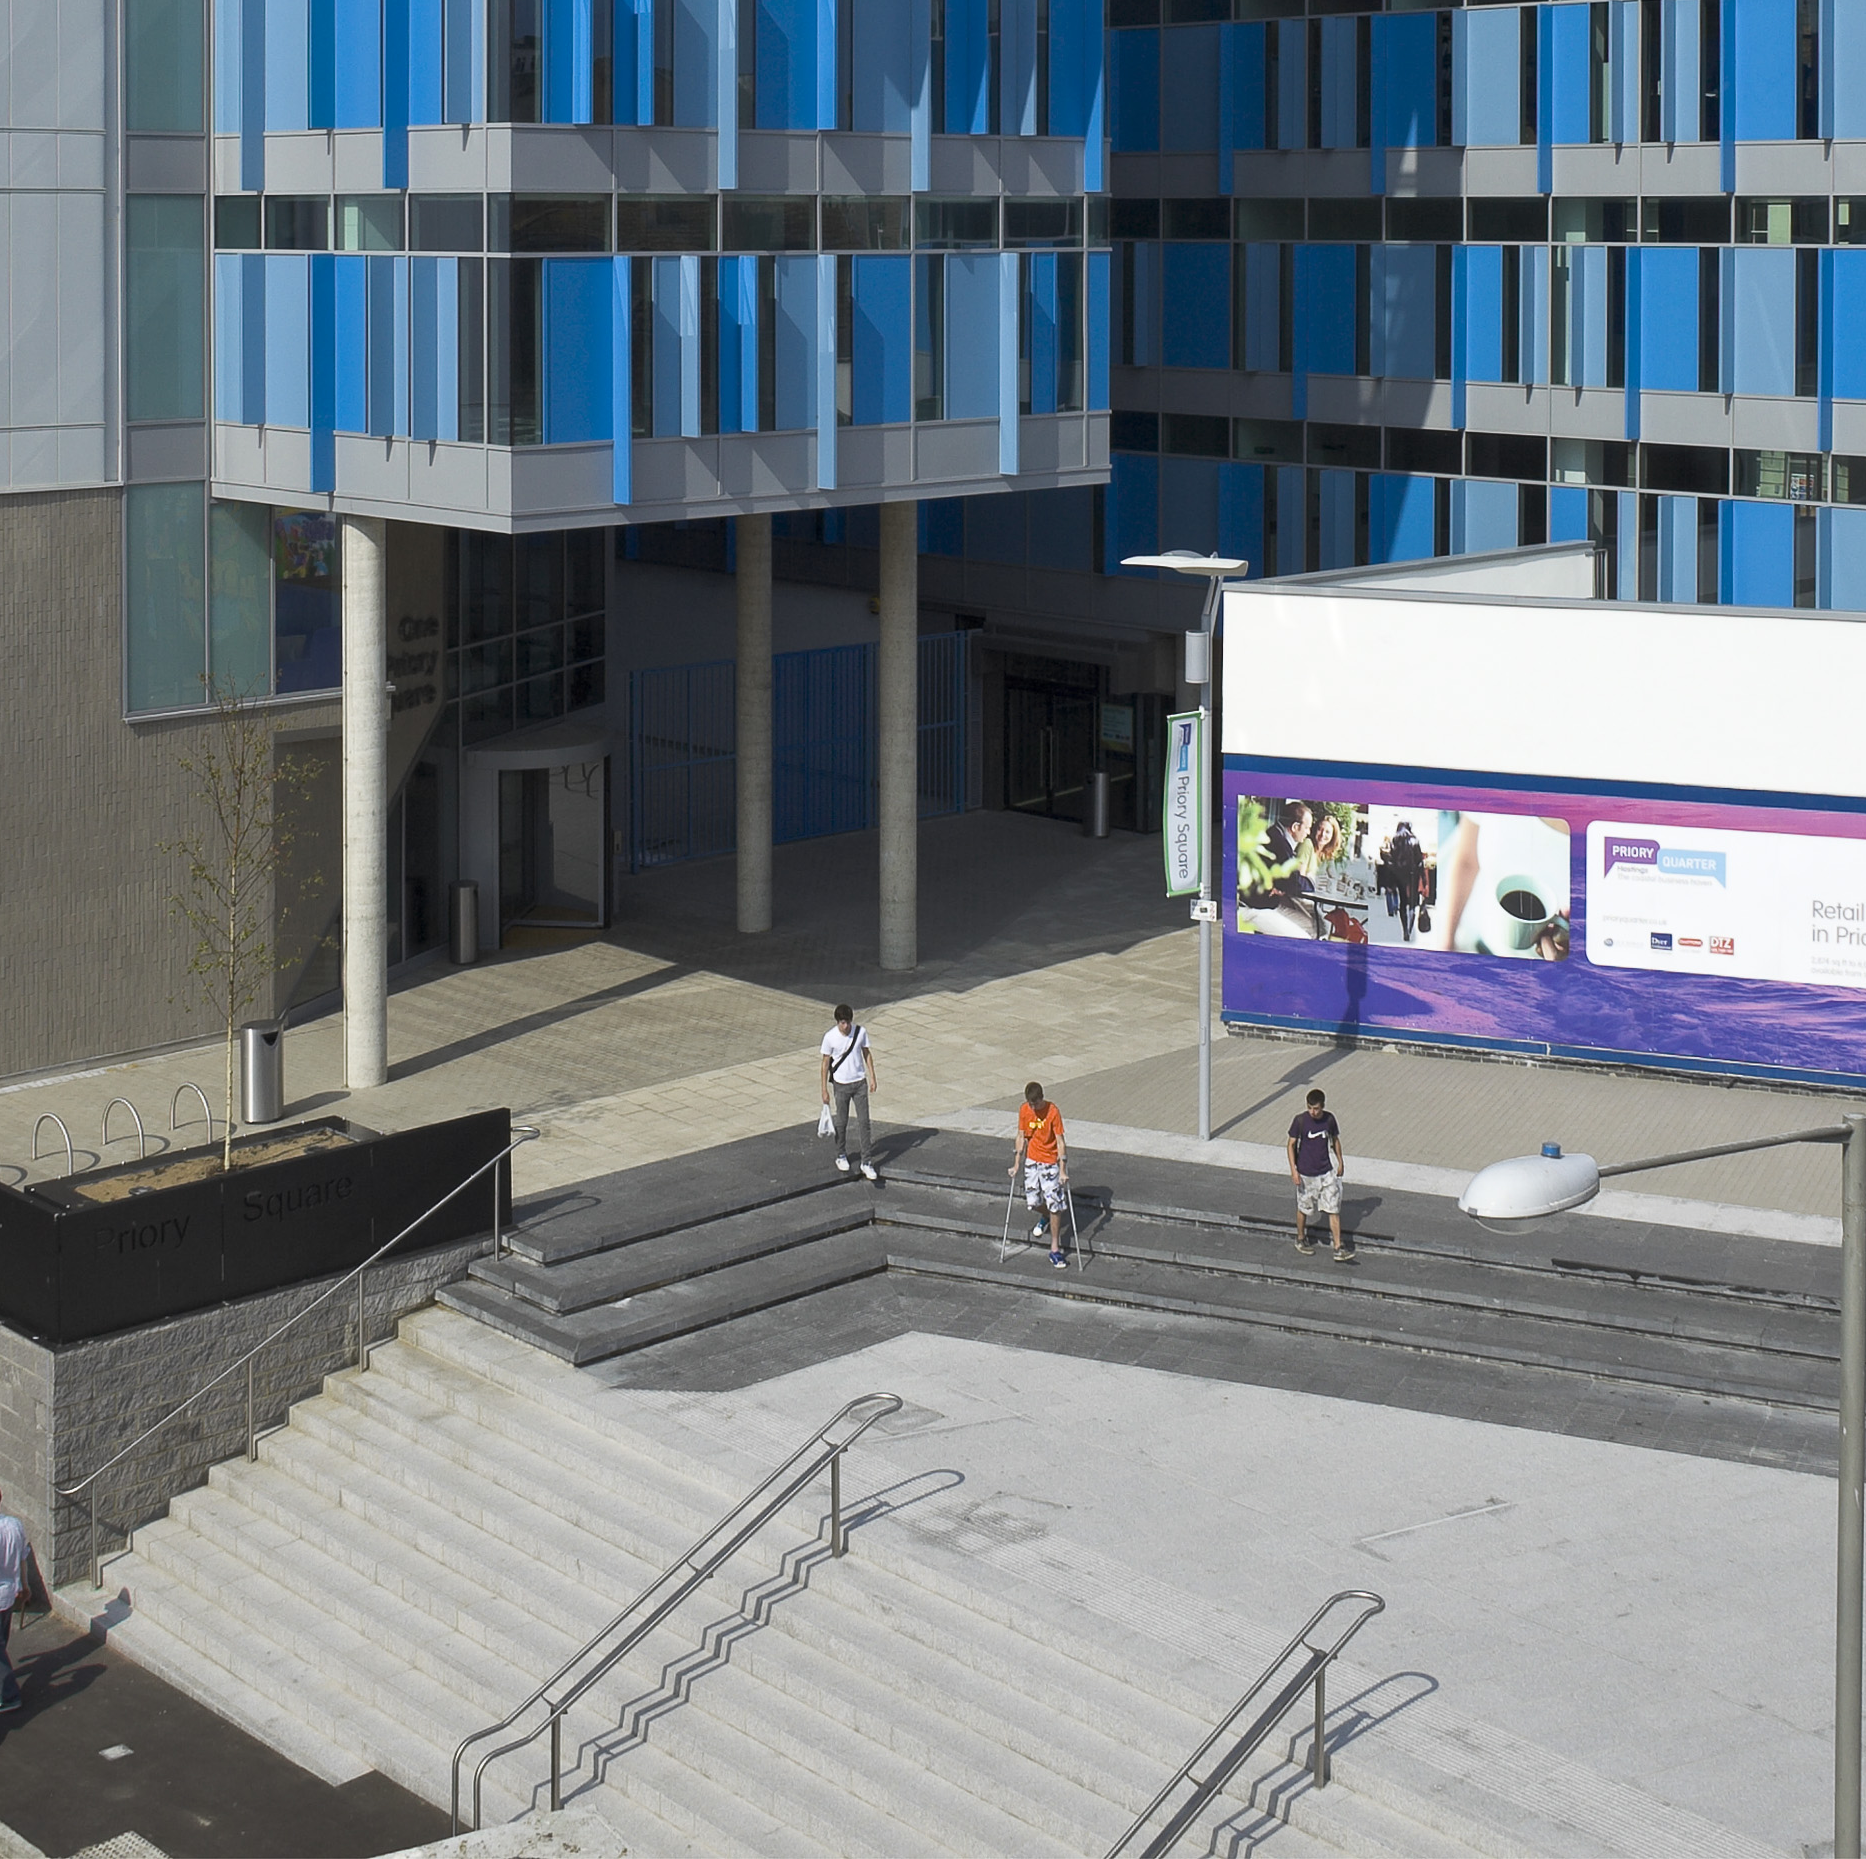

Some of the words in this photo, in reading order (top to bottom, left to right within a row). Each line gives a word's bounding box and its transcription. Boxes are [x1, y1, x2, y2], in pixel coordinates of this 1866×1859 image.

[398, 616, 439, 642] One
[1174, 776, 1190, 820] Priory
[1174, 823, 1190, 880] Square
[1612, 845, 1654, 859] PRIORY
[1662, 855, 1716, 871] QUARTER
[1812, 900, 1865, 922] Retail
[1711, 937, 1732, 948] DTZ
[1812, 924, 1829, 943] in
[94, 1214, 191, 1257] Priory
[243, 1176, 353, 1222] Square
